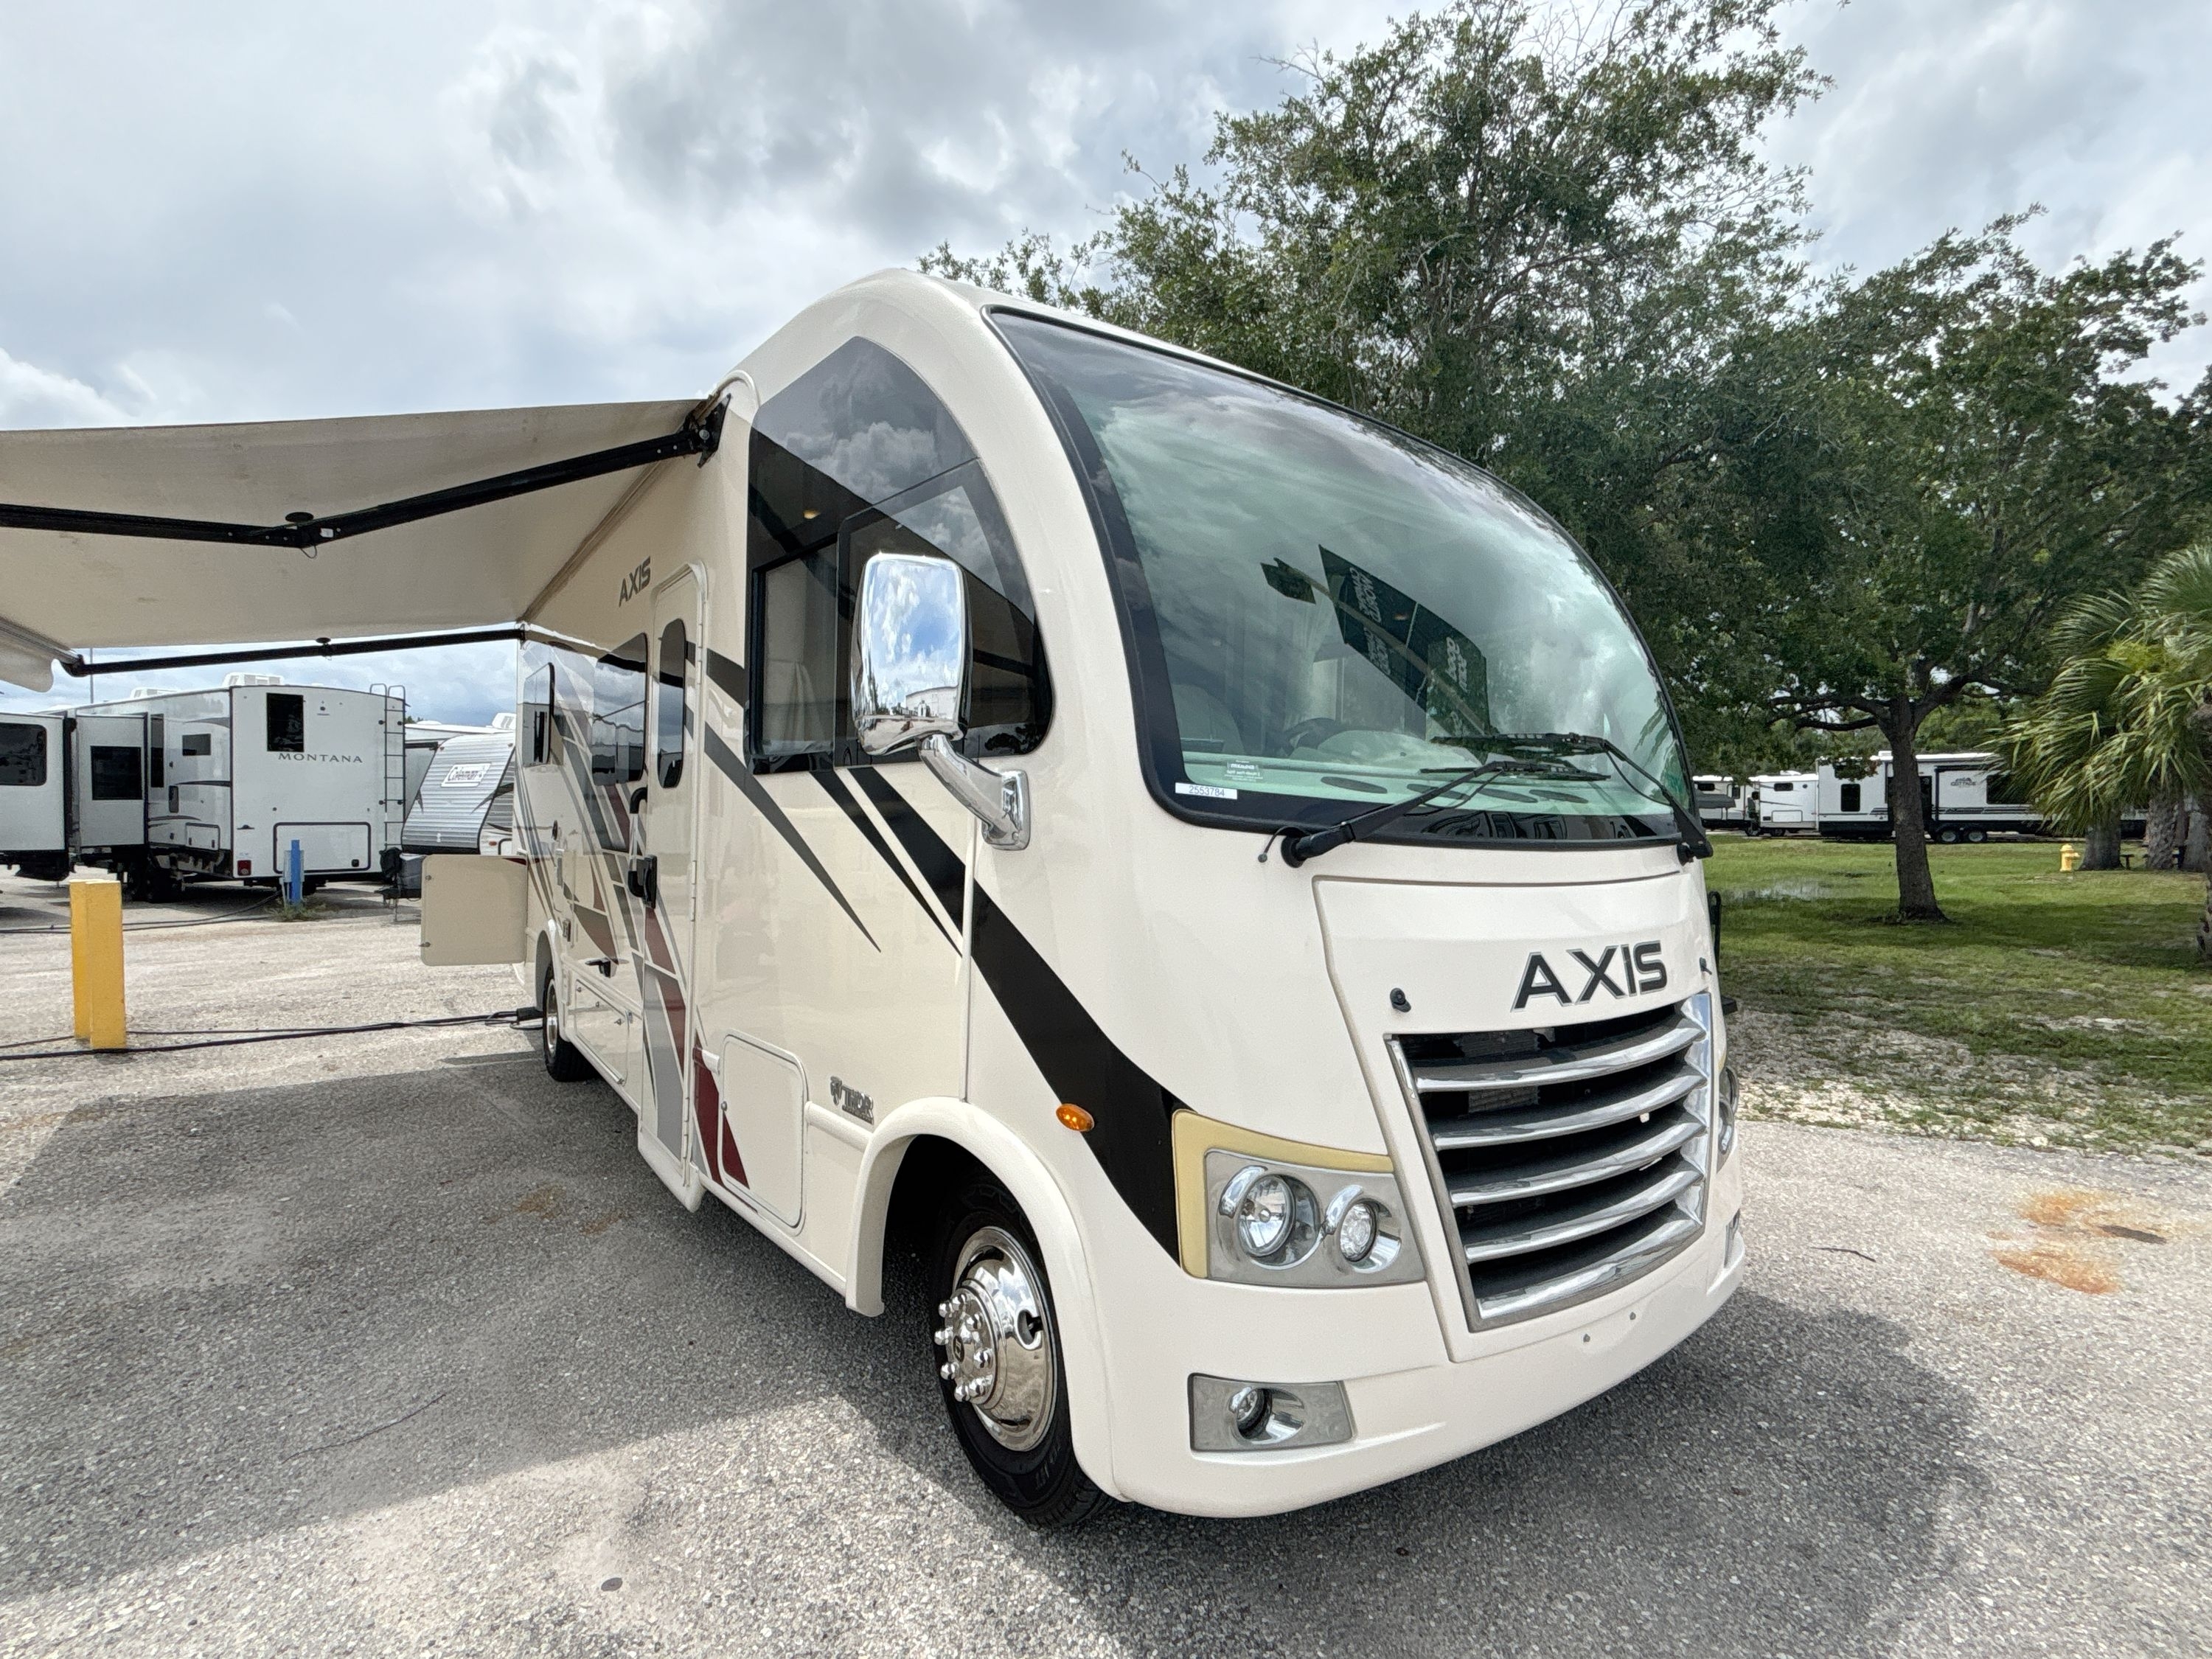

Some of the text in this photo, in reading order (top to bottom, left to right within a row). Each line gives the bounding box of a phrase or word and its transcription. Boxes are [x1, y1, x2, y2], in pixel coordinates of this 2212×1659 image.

[619, 555, 651, 608] AXIS
[278, 753, 363, 763] MONTANA
[1189, 785, 1225, 797] 2553784
[1510, 940, 1668, 1012] AXIS
[841, 1085, 874, 1117] THOR
